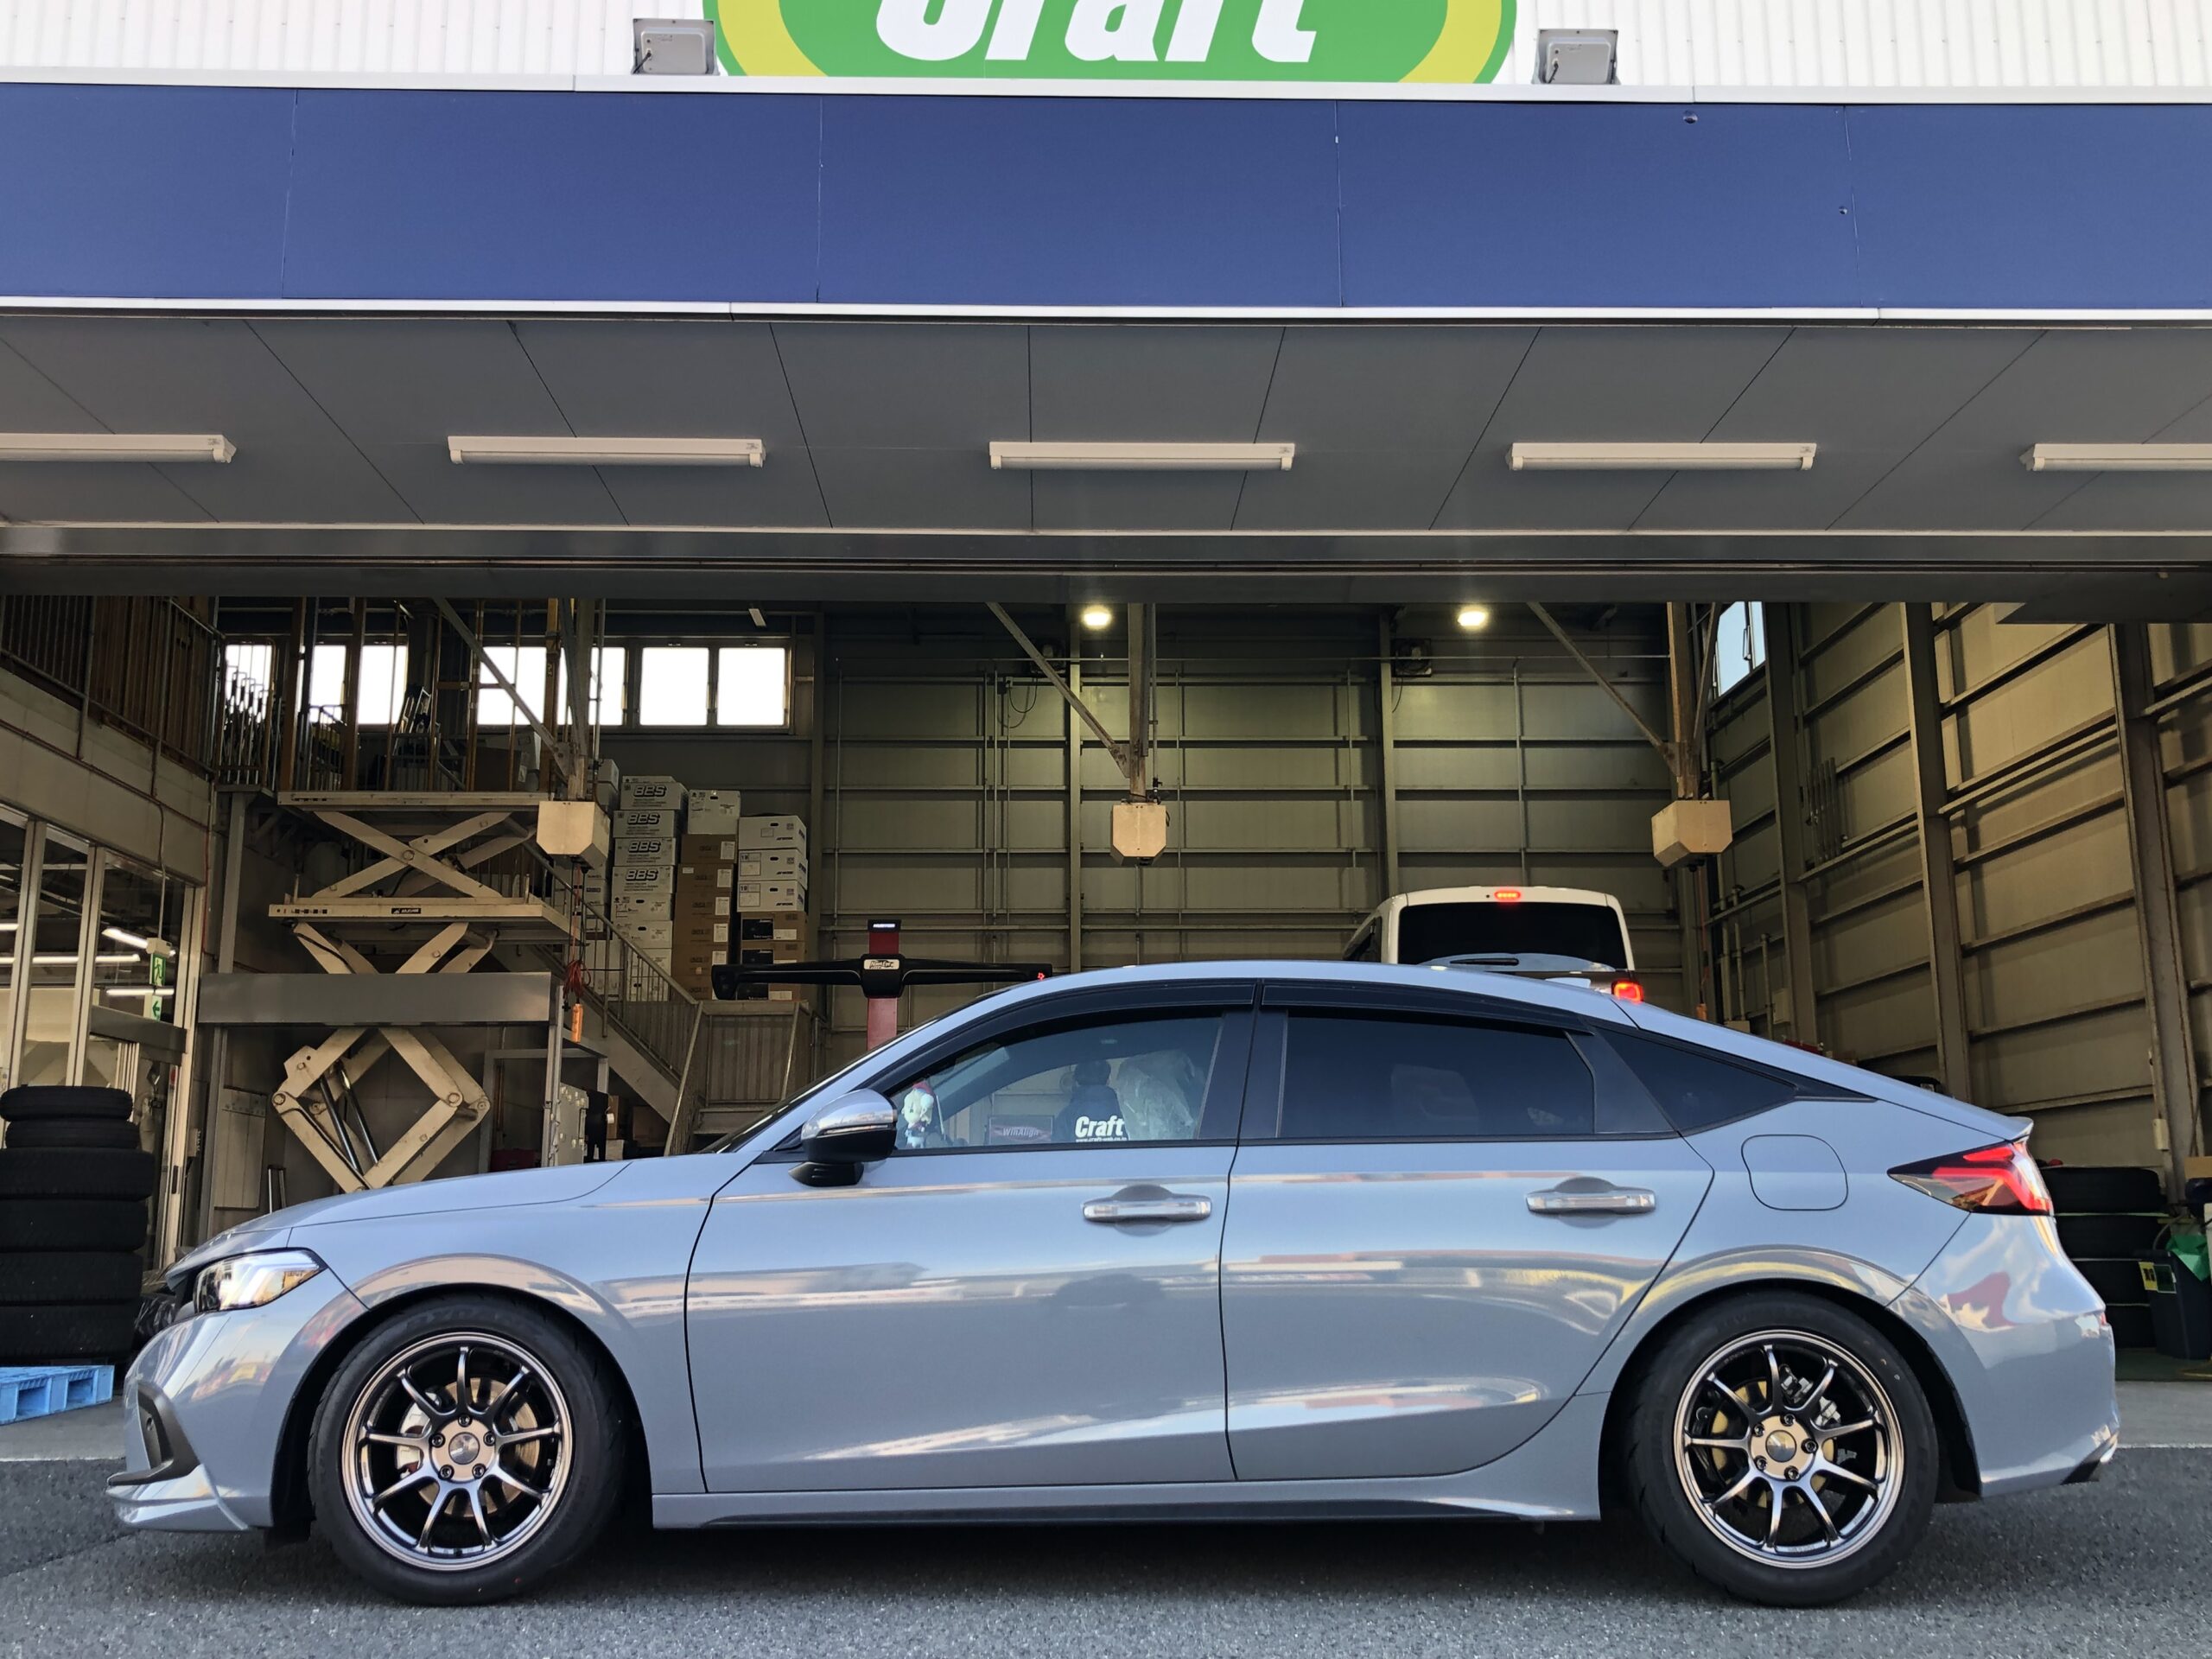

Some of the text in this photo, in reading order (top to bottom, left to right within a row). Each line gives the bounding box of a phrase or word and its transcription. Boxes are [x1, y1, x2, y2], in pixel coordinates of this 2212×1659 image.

[634, 785, 667, 798] BBS
[628, 813, 661, 825] BBS
[629, 840, 661, 854] BBS
[626, 868, 659, 881] BBS
[1075, 1116, 1125, 1137] Craft
